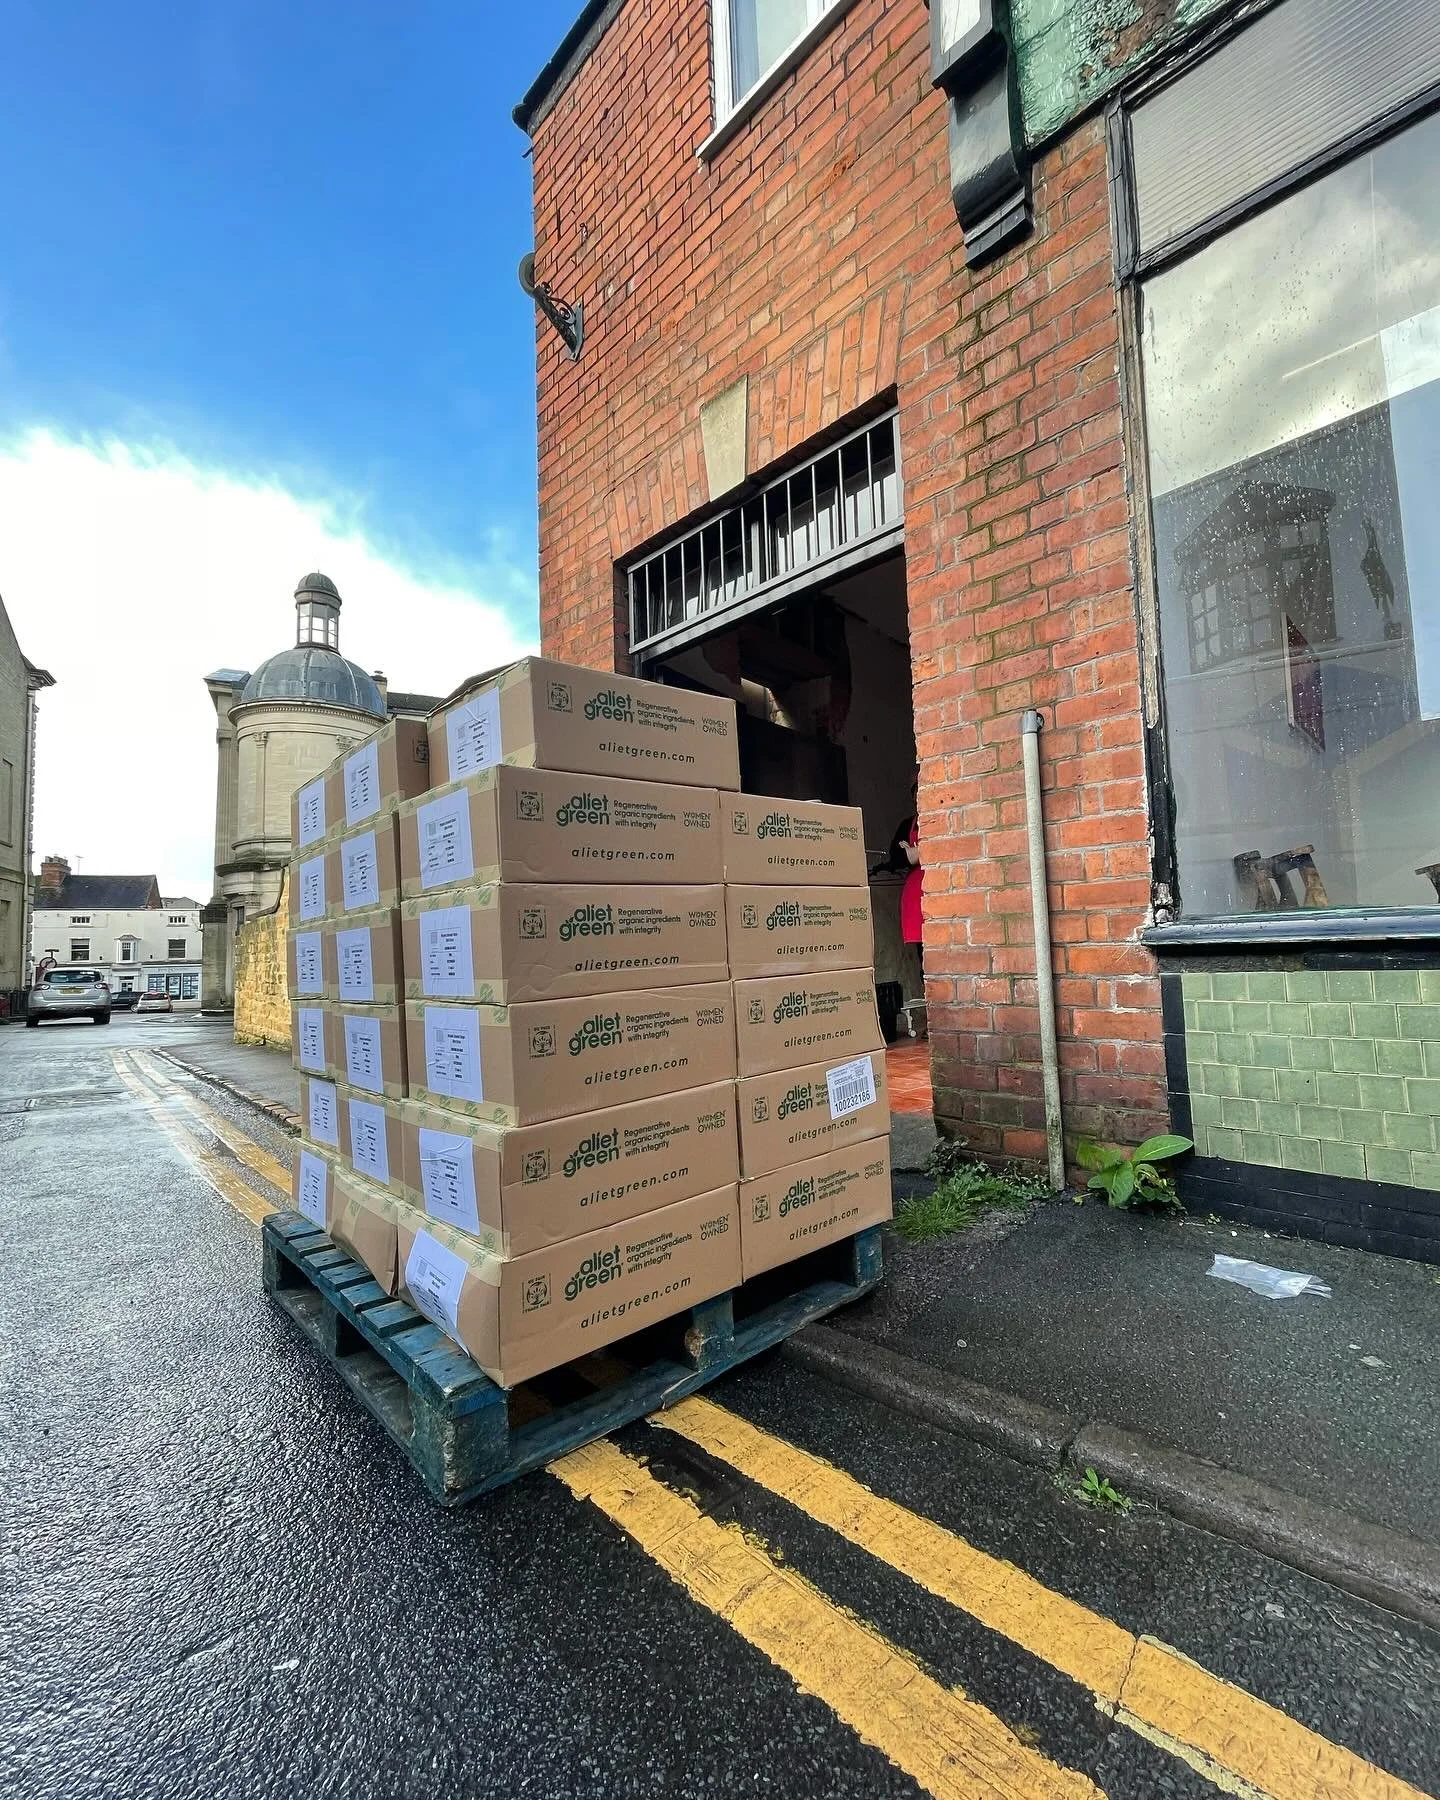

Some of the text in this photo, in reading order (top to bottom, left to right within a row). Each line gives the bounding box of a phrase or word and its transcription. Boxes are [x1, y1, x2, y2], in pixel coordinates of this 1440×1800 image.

[597, 690, 631, 710] aliet
[637, 701, 678, 714] Regenerative
[584, 700, 634, 722] green
[637, 709, 695, 725] organic ingredients
[653, 721, 677, 732] integrity
[702, 717, 728, 728] WOMEN
[702, 725, 727, 736] OWNED
[599, 742, 695, 763] alietgreen.com
[571, 793, 608, 811] aliet
[614, 800, 657, 811] Regenerative
[556, 807, 610, 827] green
[615, 810, 675, 821] organic ingredients
[683, 811, 711, 820] WOMEN
[684, 820, 710, 828] OWNED
[766, 812, 790, 826] aliet
[631, 820, 656, 830] integrity
[757, 823, 791, 839] green
[572, 848, 675, 861] alietgreen.com
[768, 856, 835, 866] alietgreen.com
[574, 904, 613, 921] aliet
[618, 908, 663, 917] Regenerative
[688, 911, 717, 919] WOMEN
[775, 901, 800, 915] aliet
[619, 915, 681, 926] organic ingredients
[689, 918, 716, 927] OWNED
[767, 914, 801, 930] green
[559, 920, 615, 942] green
[635, 927, 662, 936] integrity
[777, 943, 845, 955] alietgreen.com
[575, 955, 680, 972] alietgreen.com
[782, 991, 806, 1007] aliet
[626, 1011, 670, 1023] Regenerative
[696, 1007, 724, 1018] WOMEN
[697, 1016, 724, 1026] OWNED
[773, 1005, 808, 1024] green
[583, 1012, 621, 1035] aliet
[627, 1016, 689, 1033] organic ingredients
[568, 1031, 622, 1056] green
[628, 1029, 670, 1042] with integrity
[784, 1029, 852, 1047] alietgreen.com
[585, 1057, 688, 1084] alietgreen.com
[787, 1083, 811, 1100] aliet
[697, 1110, 725, 1124] WOMEN
[778, 1097, 812, 1120] green
[624, 1119, 670, 1138] Regenerative
[698, 1119, 725, 1133] OWNED
[789, 1117, 857, 1143] alietgreen.com
[579, 1128, 619, 1152] aliet
[625, 1124, 689, 1147] organic ingredients
[625, 1140, 670, 1157] with integrity
[563, 1147, 619, 1178] green
[580, 1166, 689, 1207] alietgreen.com
[789, 1176, 814, 1198] aliet
[779, 1191, 815, 1218] green
[700, 1214, 730, 1231] WOMEN
[790, 1207, 858, 1240] alietgreen.com
[701, 1224, 729, 1241] OWNED
[626, 1231, 673, 1254] Regenerative
[627, 1232, 692, 1263] organic ingredients
[580, 1245, 620, 1276] aliet
[627, 1252, 672, 1274] with integrity
[564, 1263, 622, 1301] green
[581, 1276, 691, 1329] alietgreen.com
